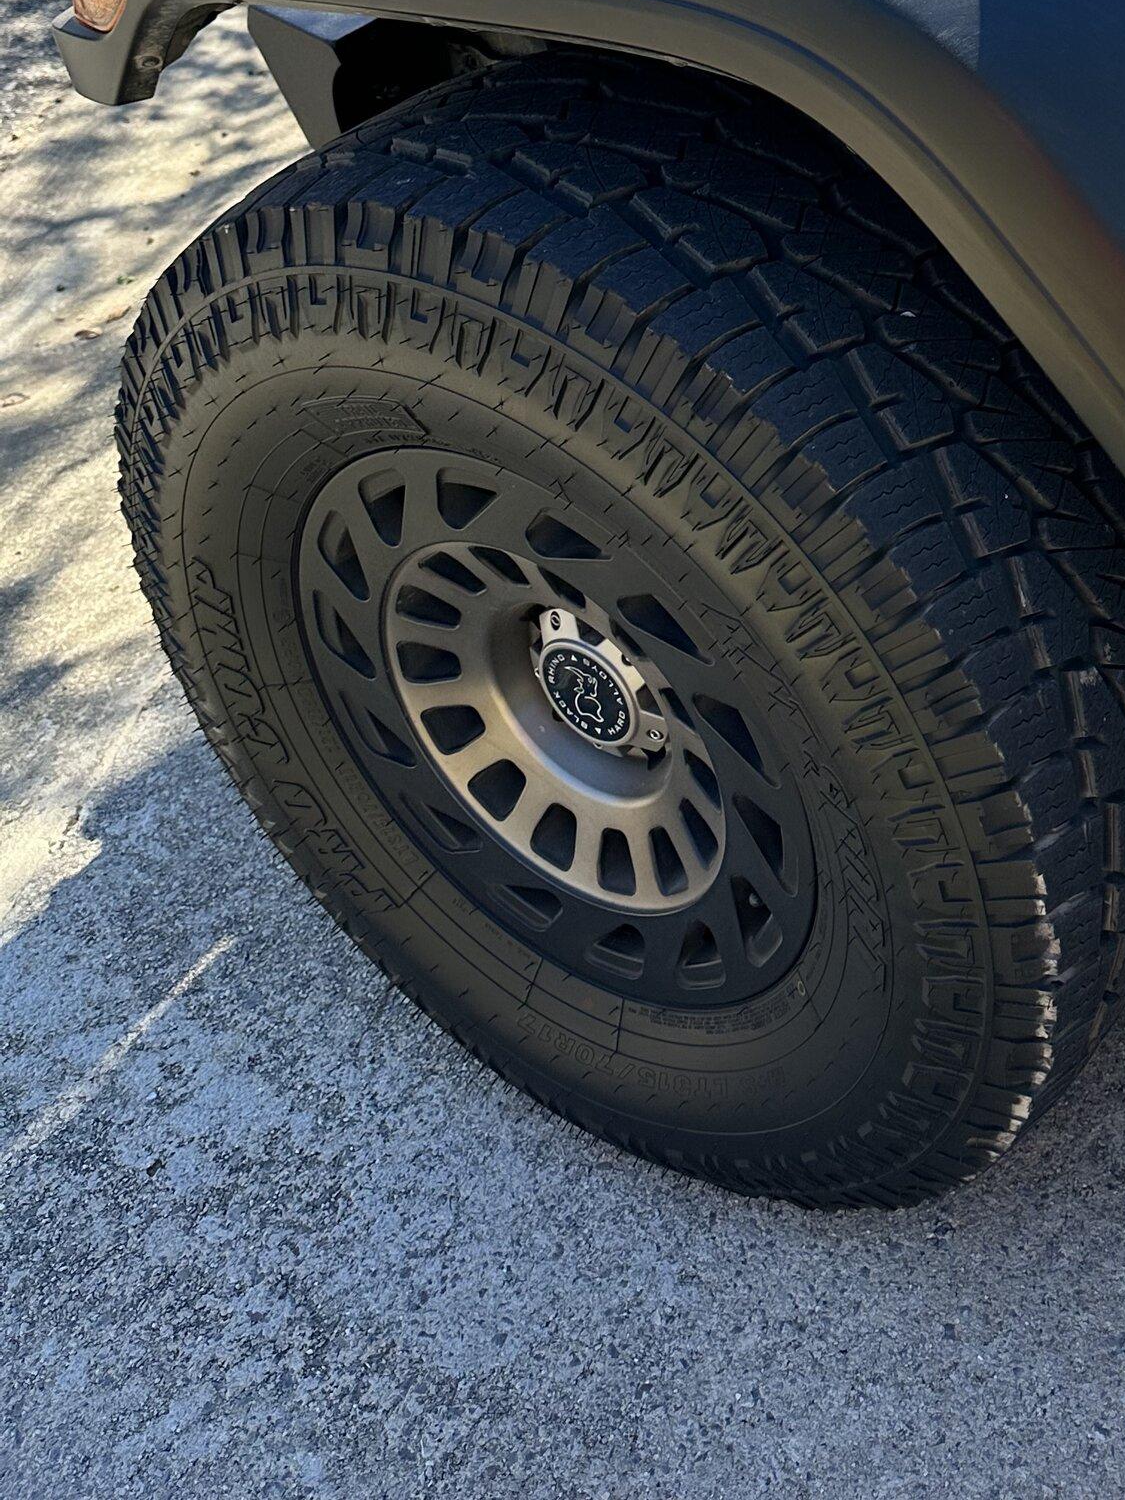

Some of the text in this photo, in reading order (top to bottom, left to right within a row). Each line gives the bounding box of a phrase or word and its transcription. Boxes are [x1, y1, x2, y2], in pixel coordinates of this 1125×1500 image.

[548, 654, 589, 730] BLACK RHINO
[582, 657, 626, 736] HARD ALLOYS
